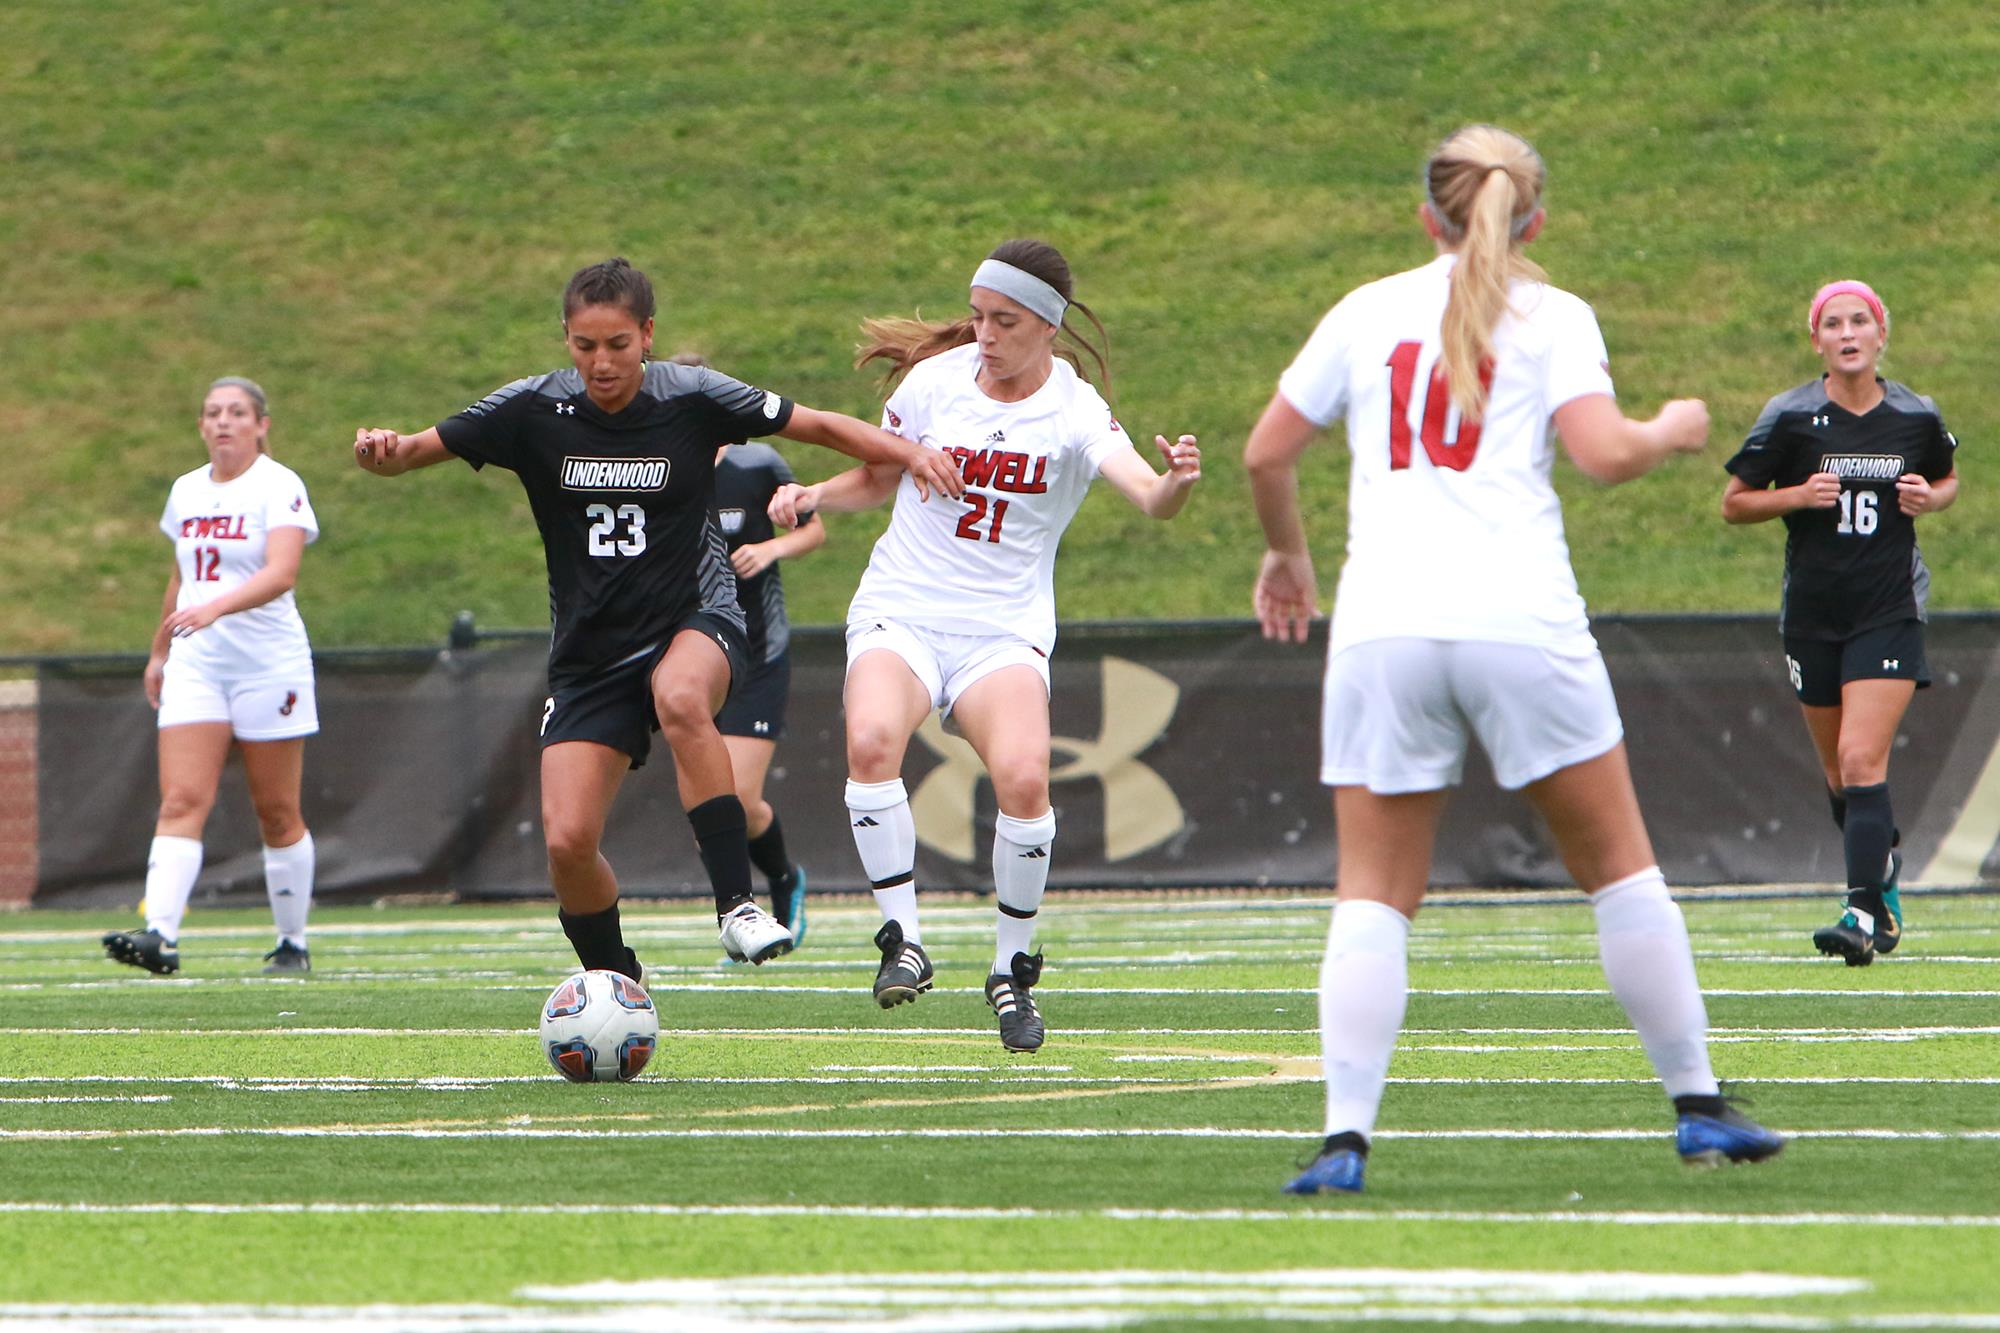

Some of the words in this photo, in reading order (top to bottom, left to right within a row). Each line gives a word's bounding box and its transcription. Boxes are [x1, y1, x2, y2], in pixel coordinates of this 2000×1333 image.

[1386, 339, 1496, 472] 10
[564, 460, 666, 488] LINDENWOOD
[942, 446, 1047, 494] EWELL
[1823, 457, 1902, 479] LINDENWOOD
[182, 515, 248, 540] EWELL
[586, 503, 647, 557] 23
[955, 492, 1009, 543] 21
[1837, 489, 1879, 535] 16
[195, 546, 221, 582] 12
